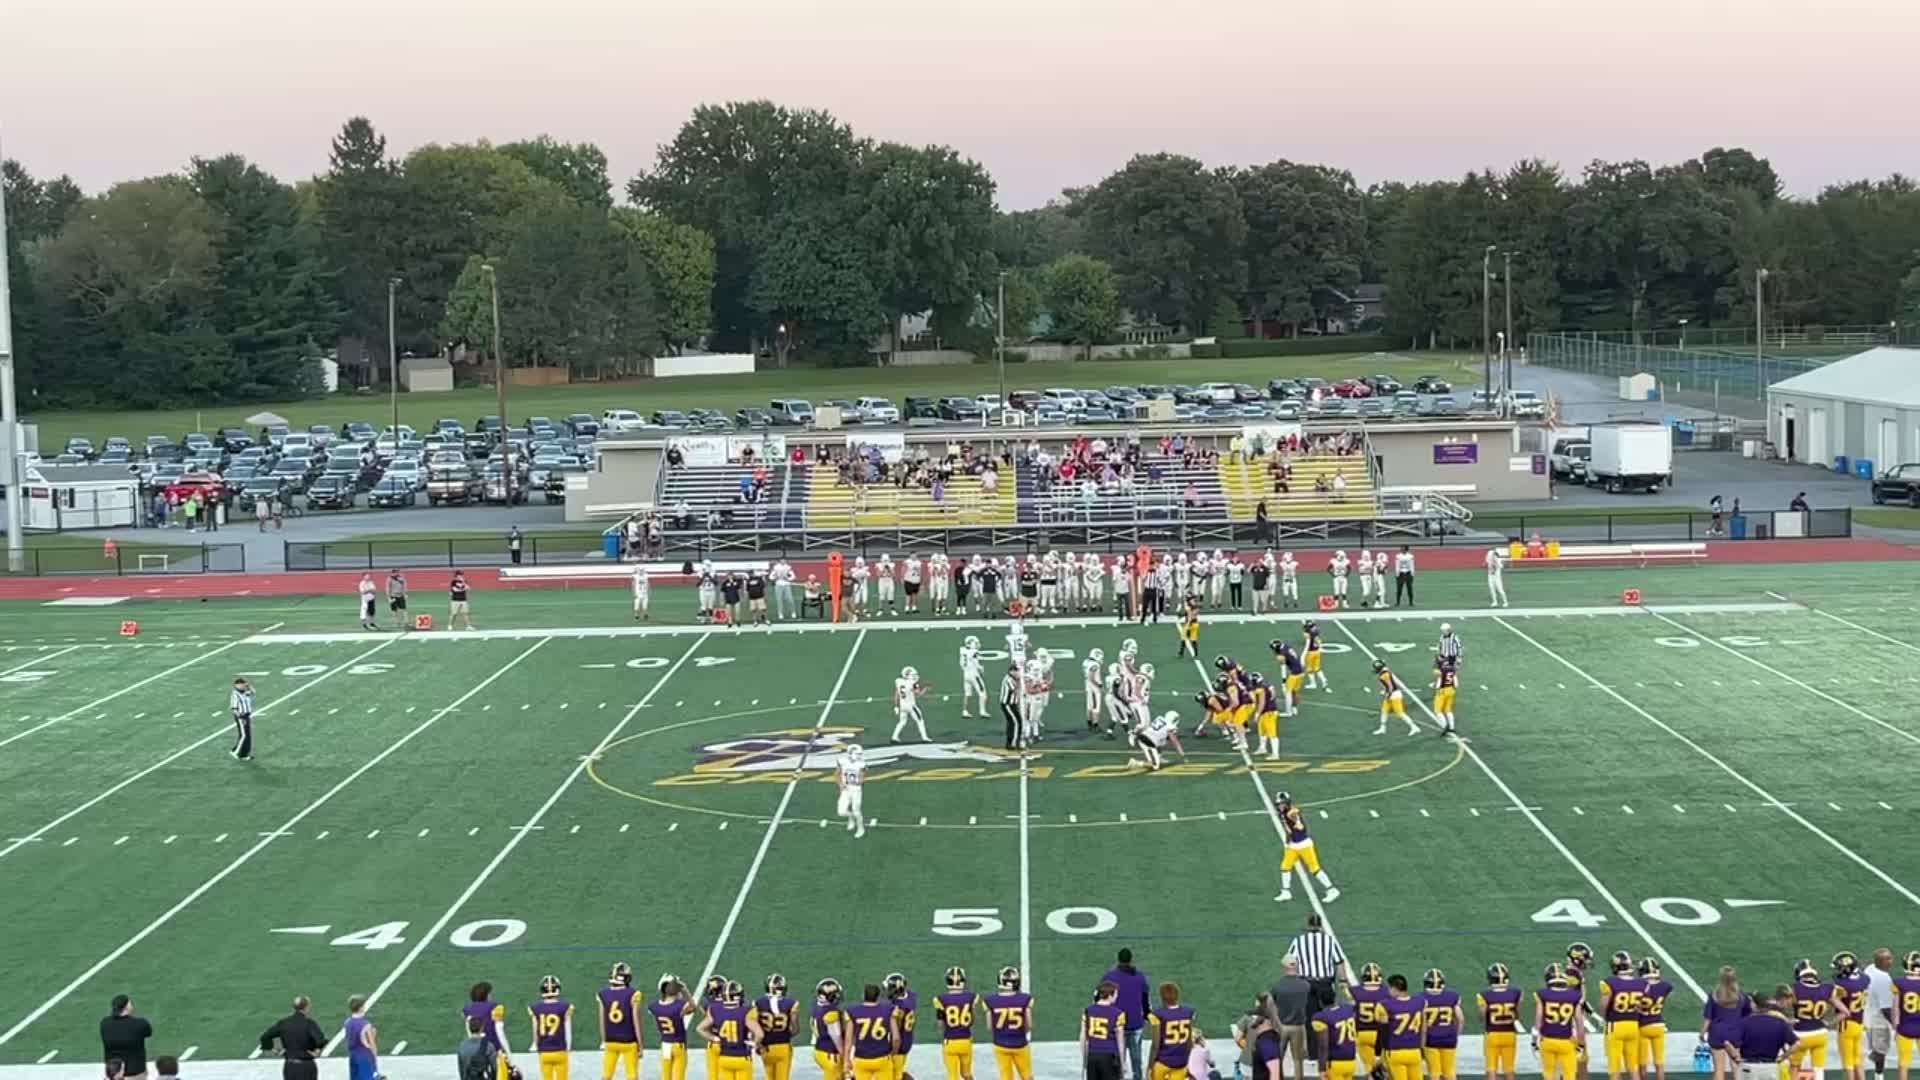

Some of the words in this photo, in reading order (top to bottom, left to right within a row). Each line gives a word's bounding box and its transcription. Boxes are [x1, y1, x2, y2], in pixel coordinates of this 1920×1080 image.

[608, 1000, 624, 1024] 6
[1358, 1001, 1377, 1023] 5
[1489, 1002, 1516, 1025] 25
[1544, 1001, 1574, 1026] 59
[1614, 991, 1643, 1014] 85
[1797, 999, 1827, 1020] 20
[1903, 991, 1920, 1014] 8
[538, 1013, 562, 1037] 19
[657, 1016, 675, 1035] 3
[758, 1011, 789, 1033] 33
[945, 1003, 972, 1028] 86
[993, 1007, 1024, 1030] 75
[1393, 1010, 1422, 1036] 74
[1424, 1005, 1453, 1027] 73
[718, 1019, 739, 1043] 41
[854, 1016, 888, 1041] 76
[1087, 1016, 1109, 1040] 15
[1164, 1019, 1191, 1045] 55
[1334, 1016, 1356, 1046] 78
